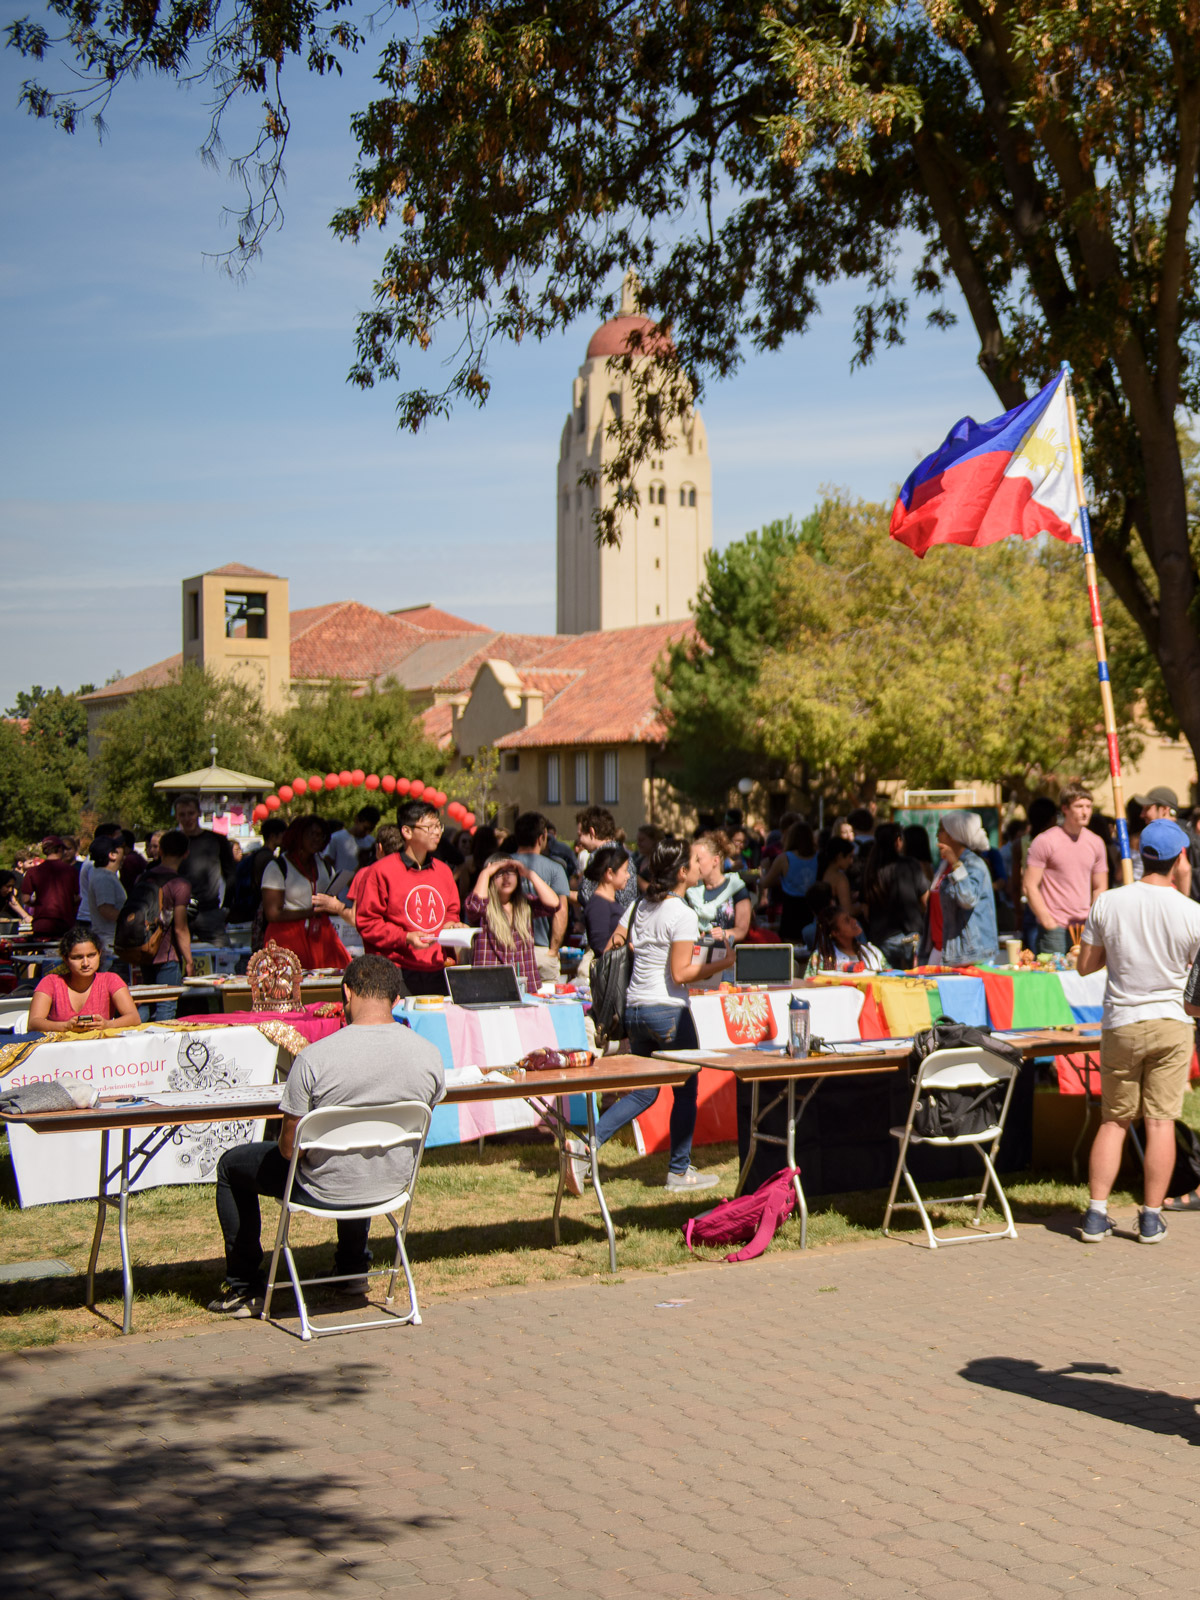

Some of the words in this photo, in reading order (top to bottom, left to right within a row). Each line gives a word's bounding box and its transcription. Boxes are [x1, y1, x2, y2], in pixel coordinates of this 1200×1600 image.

[11, 1064, 94, 1089] stanford
[102, 1058, 167, 1079] noopur
[97, 1081, 136, 1092] rd-winning
